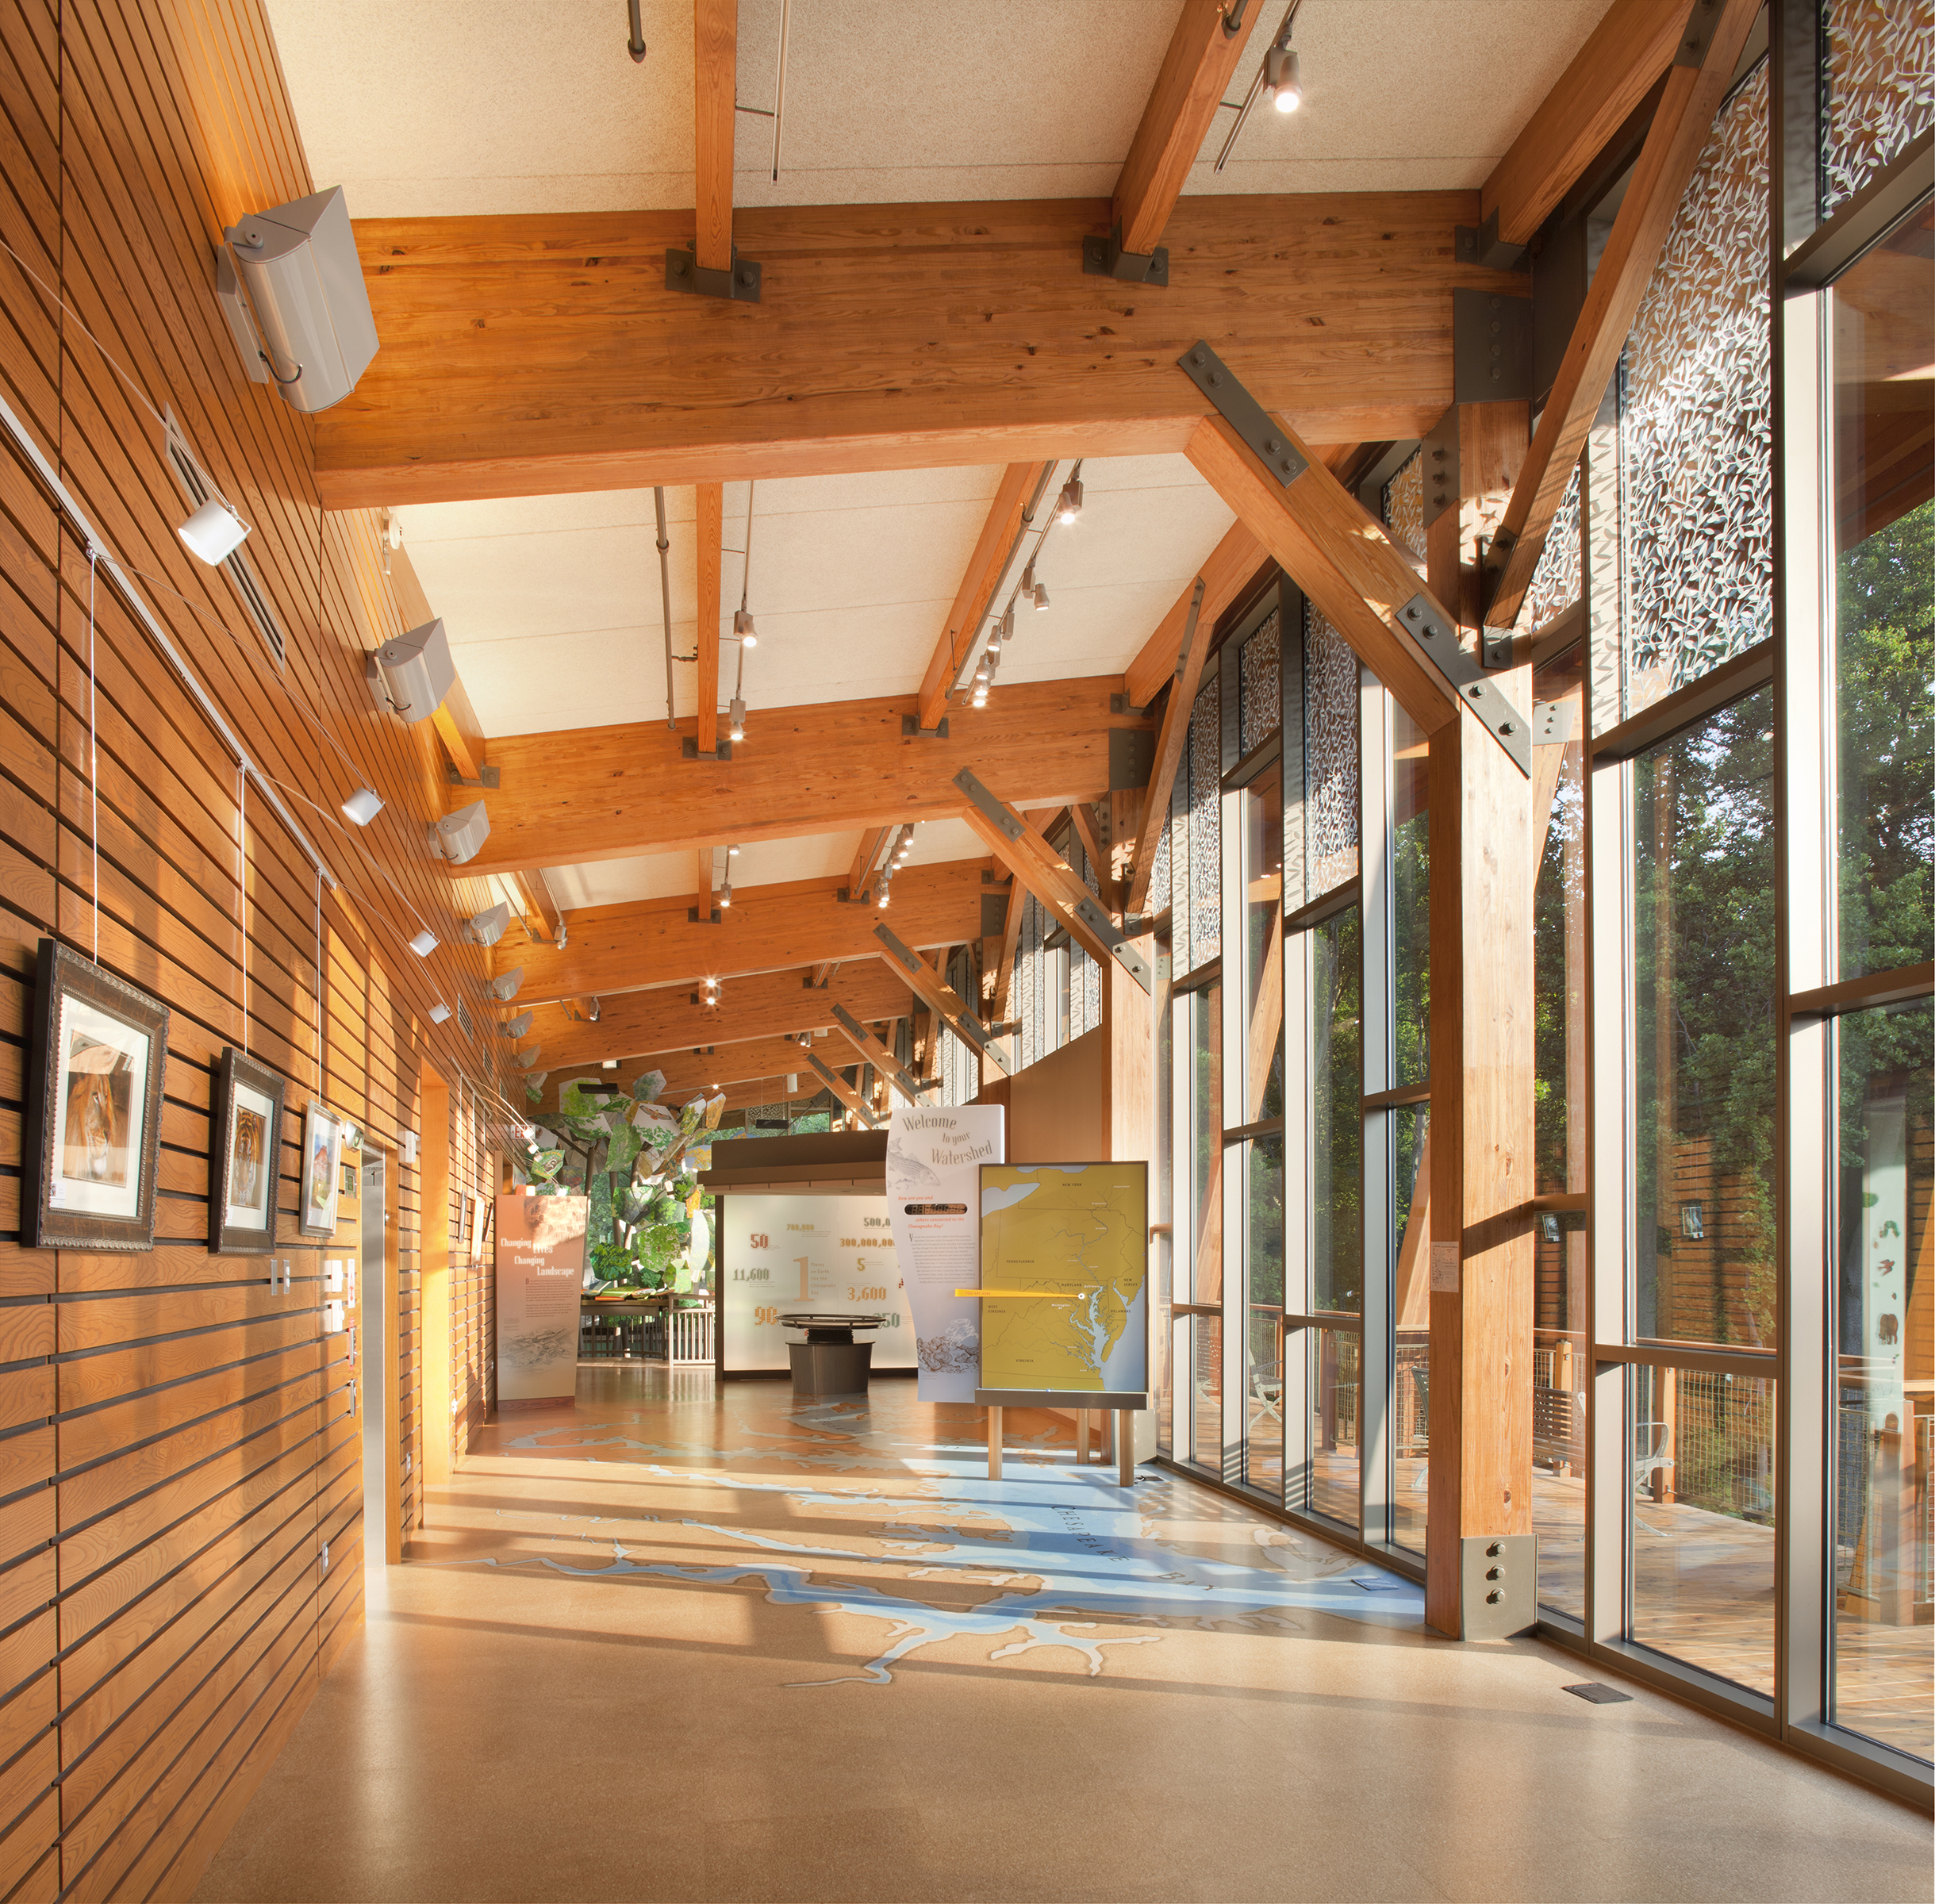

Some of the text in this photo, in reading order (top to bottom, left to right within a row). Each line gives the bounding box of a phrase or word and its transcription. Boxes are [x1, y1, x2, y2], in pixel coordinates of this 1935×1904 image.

[902, 1114, 957, 1131] Welcome
[943, 1132, 970, 1146] to your
[931, 1139, 992, 1165] Watershed
[370, 1170, 375, 1186] 1
[501, 1238, 532, 1249] Changing
[533, 1242, 553, 1253] Lives
[751, 1234, 769, 1249] 50
[514, 1255, 545, 1266] Changing
[857, 1257, 866, 1272] 5
[537, 1266, 574, 1277] Landscape
[732, 1269, 770, 1281] 11,600
[793, 1256, 815, 1302] 1
[847, 1287, 886, 1302] 3,600
[754, 1307, 777, 1325] 90
[1051, 1504, 1224, 1591] CHESAPEAKE BAY
